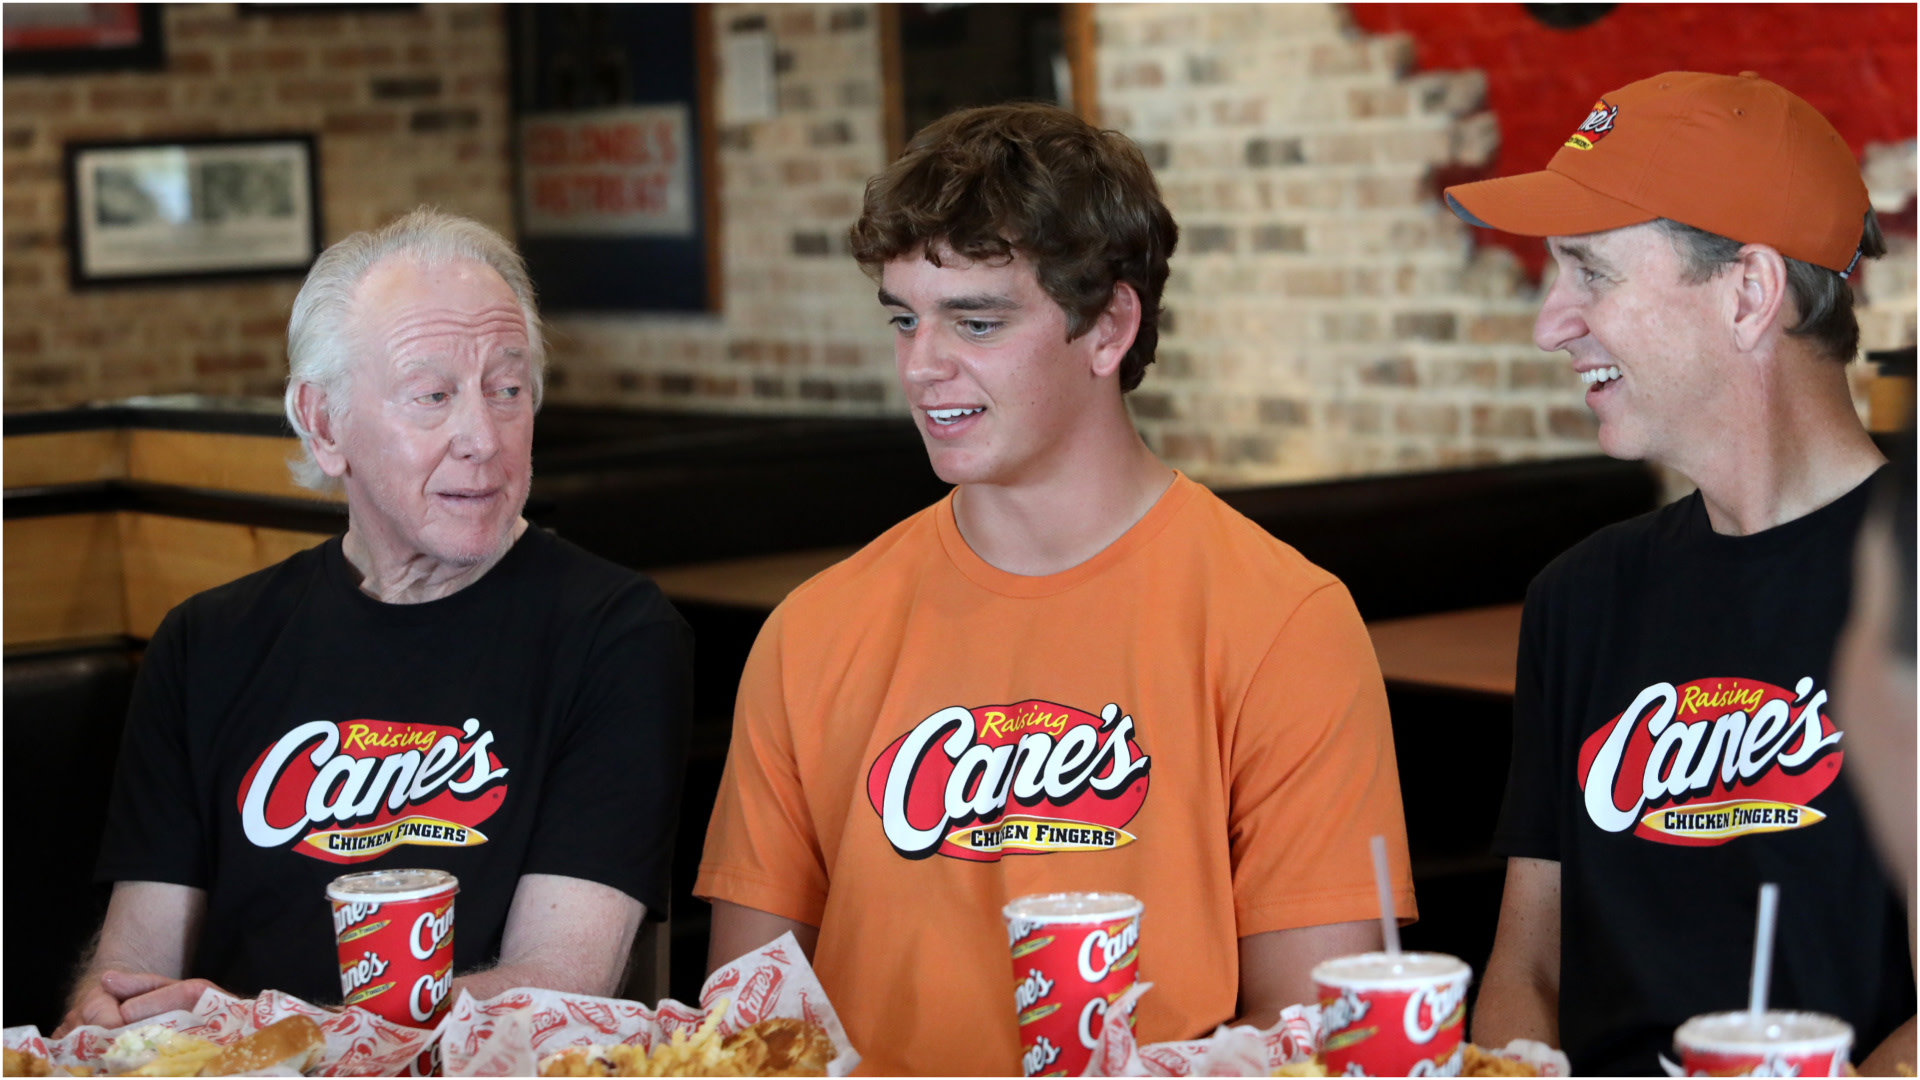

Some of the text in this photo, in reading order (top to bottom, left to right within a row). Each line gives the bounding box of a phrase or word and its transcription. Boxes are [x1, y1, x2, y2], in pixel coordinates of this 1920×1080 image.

[1678, 682, 1764, 714] Raising
[980, 704, 1069, 738] Raising
[343, 723, 437, 752] Raising
[1584, 676, 1845, 833] Cane's
[242, 717, 510, 848] Cane's
[882, 703, 1150, 852] Cane's
[1664, 807, 1799, 830] CHICKEN FINGERS
[328, 823, 467, 851] CHICKEN FINGERS
[1035, 824, 1116, 846] FINGERS
